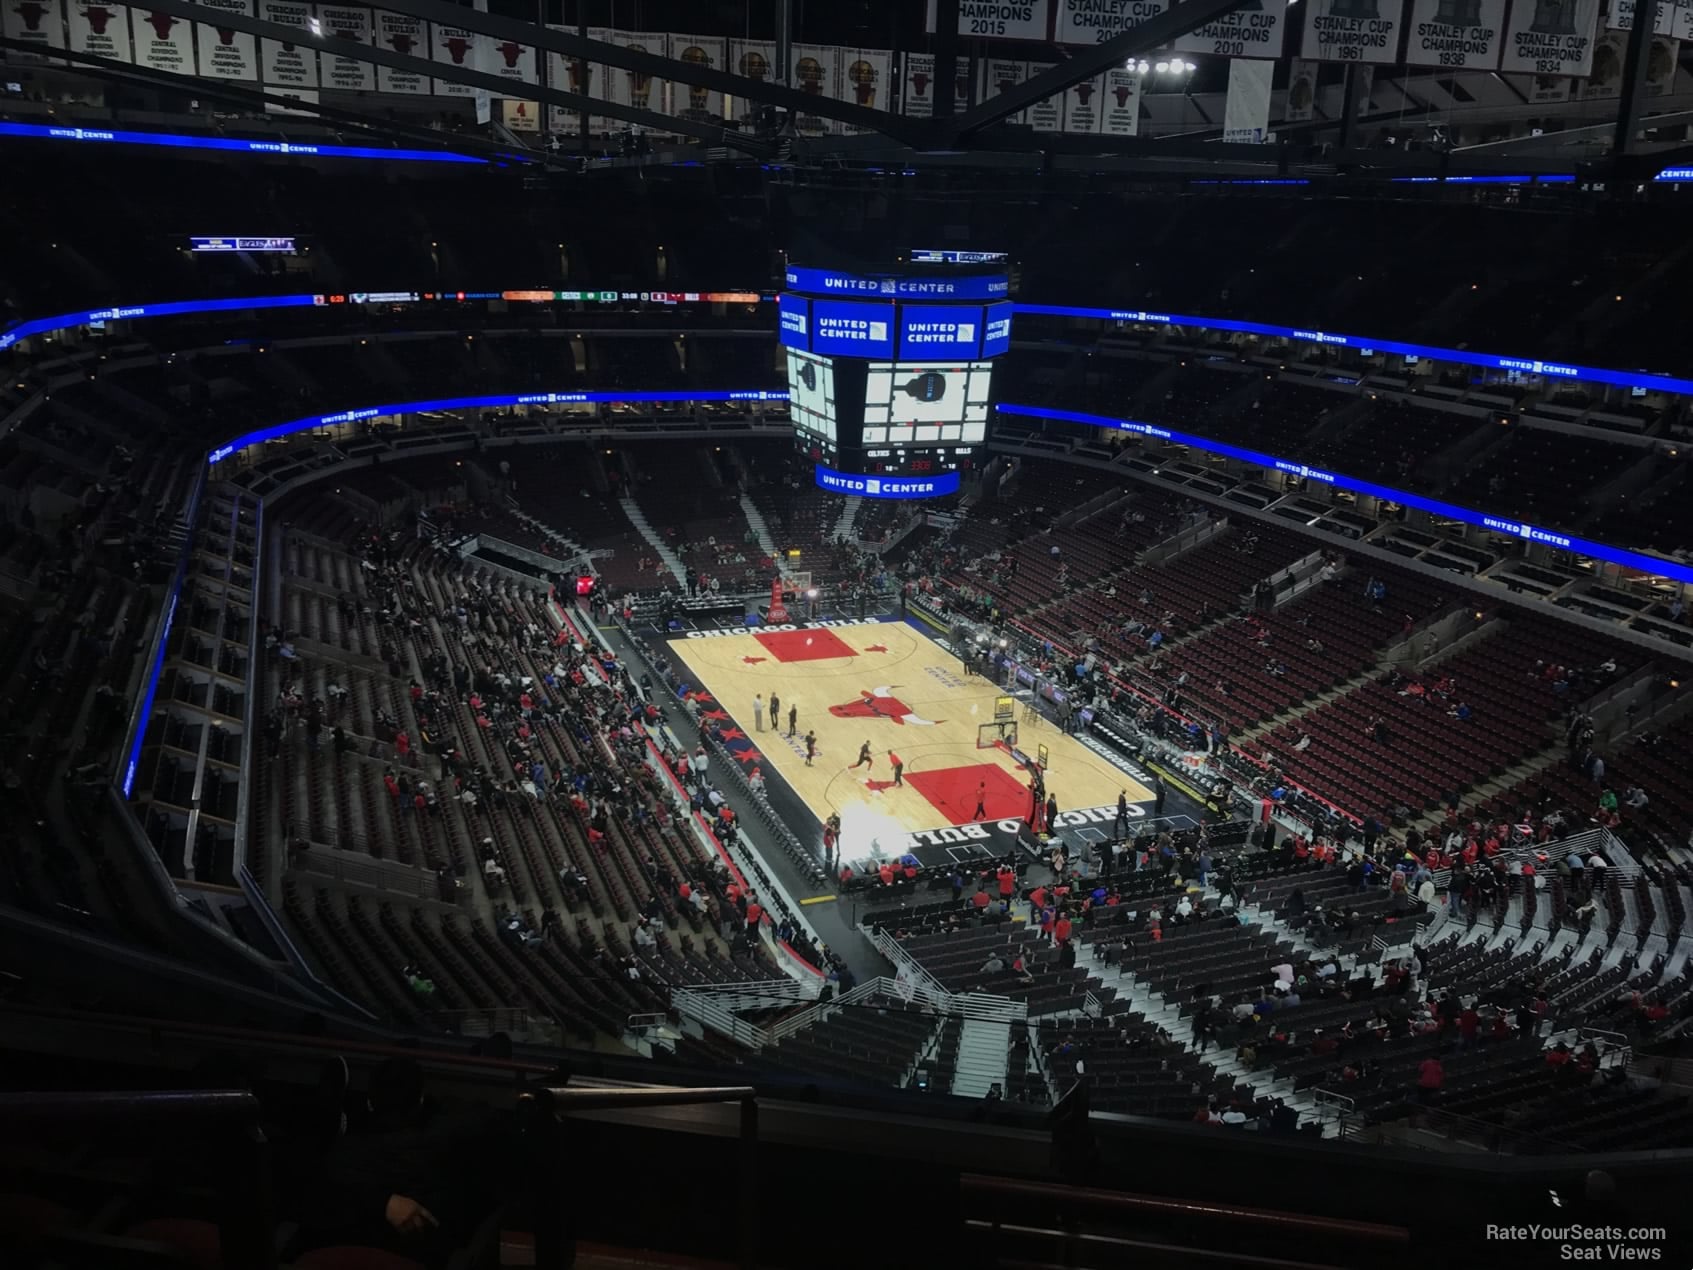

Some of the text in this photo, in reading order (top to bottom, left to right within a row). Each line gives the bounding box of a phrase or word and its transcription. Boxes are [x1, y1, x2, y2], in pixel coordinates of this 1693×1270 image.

[266, 4, 307, 16] CHICAGO
[323, 10, 364, 21] CHICAGO
[960, 5, 1033, 21] HAMPIONS
[1067, 0, 1161, 17] STANLEY CUP
[971, 20, 1005, 35] 2015
[1073, 14, 1148, 29] CHAMPION
[1250, 14, 1276, 28] CUP
[1314, 17, 1393, 34] STANLEY CUP
[1318, 31, 1387, 47] CHAMPIONS
[1418, 24, 1494, 41] STANLEY CUP
[1214, 40, 1244, 55] 2010
[1422, 38, 1488, 54] CHAMPIONS
[1515, 32, 1588, 49] STANLEY CUP
[1338, 47, 1364, 60] 1961
[1439, 53, 1466, 66] 1938
[1518, 46, 1582, 62] CHAMPIONS
[1536, 60, 1561, 73] 1934
[517, 103, 526, 117] 4
[50, 129, 113, 139] UNITED CENTER
[250, 143, 318, 153] UNITED CENTER
[825, 278, 954, 293] UNITED CENTER
[90, 308, 144, 320] UNITED CENTER
[781, 311, 799, 321] UNITED
[782, 321, 799, 331] CENTER
[820, 318, 867, 329] UNITED
[908, 323, 956, 332] UNITED
[988, 320, 1003, 330] UNITED
[820, 329, 867, 339] CENTER
[908, 333, 955, 342] CENTER
[986, 331, 1002, 341] CENTER
[1293, 331, 1347, 343] UNITED CENTER
[1500, 359, 1578, 376] UNITED CENTER
[321, 409, 378, 423] UNITED CENTER
[1121, 422, 1171, 438] UNITED CENTER
[1276, 460, 1334, 482] UNITED CENTER
[823, 475, 934, 493] UNITED CENTER
[1484, 518, 1570, 547] UNITED CENTER
[686, 617, 880, 638] CHICAGO BULLS
